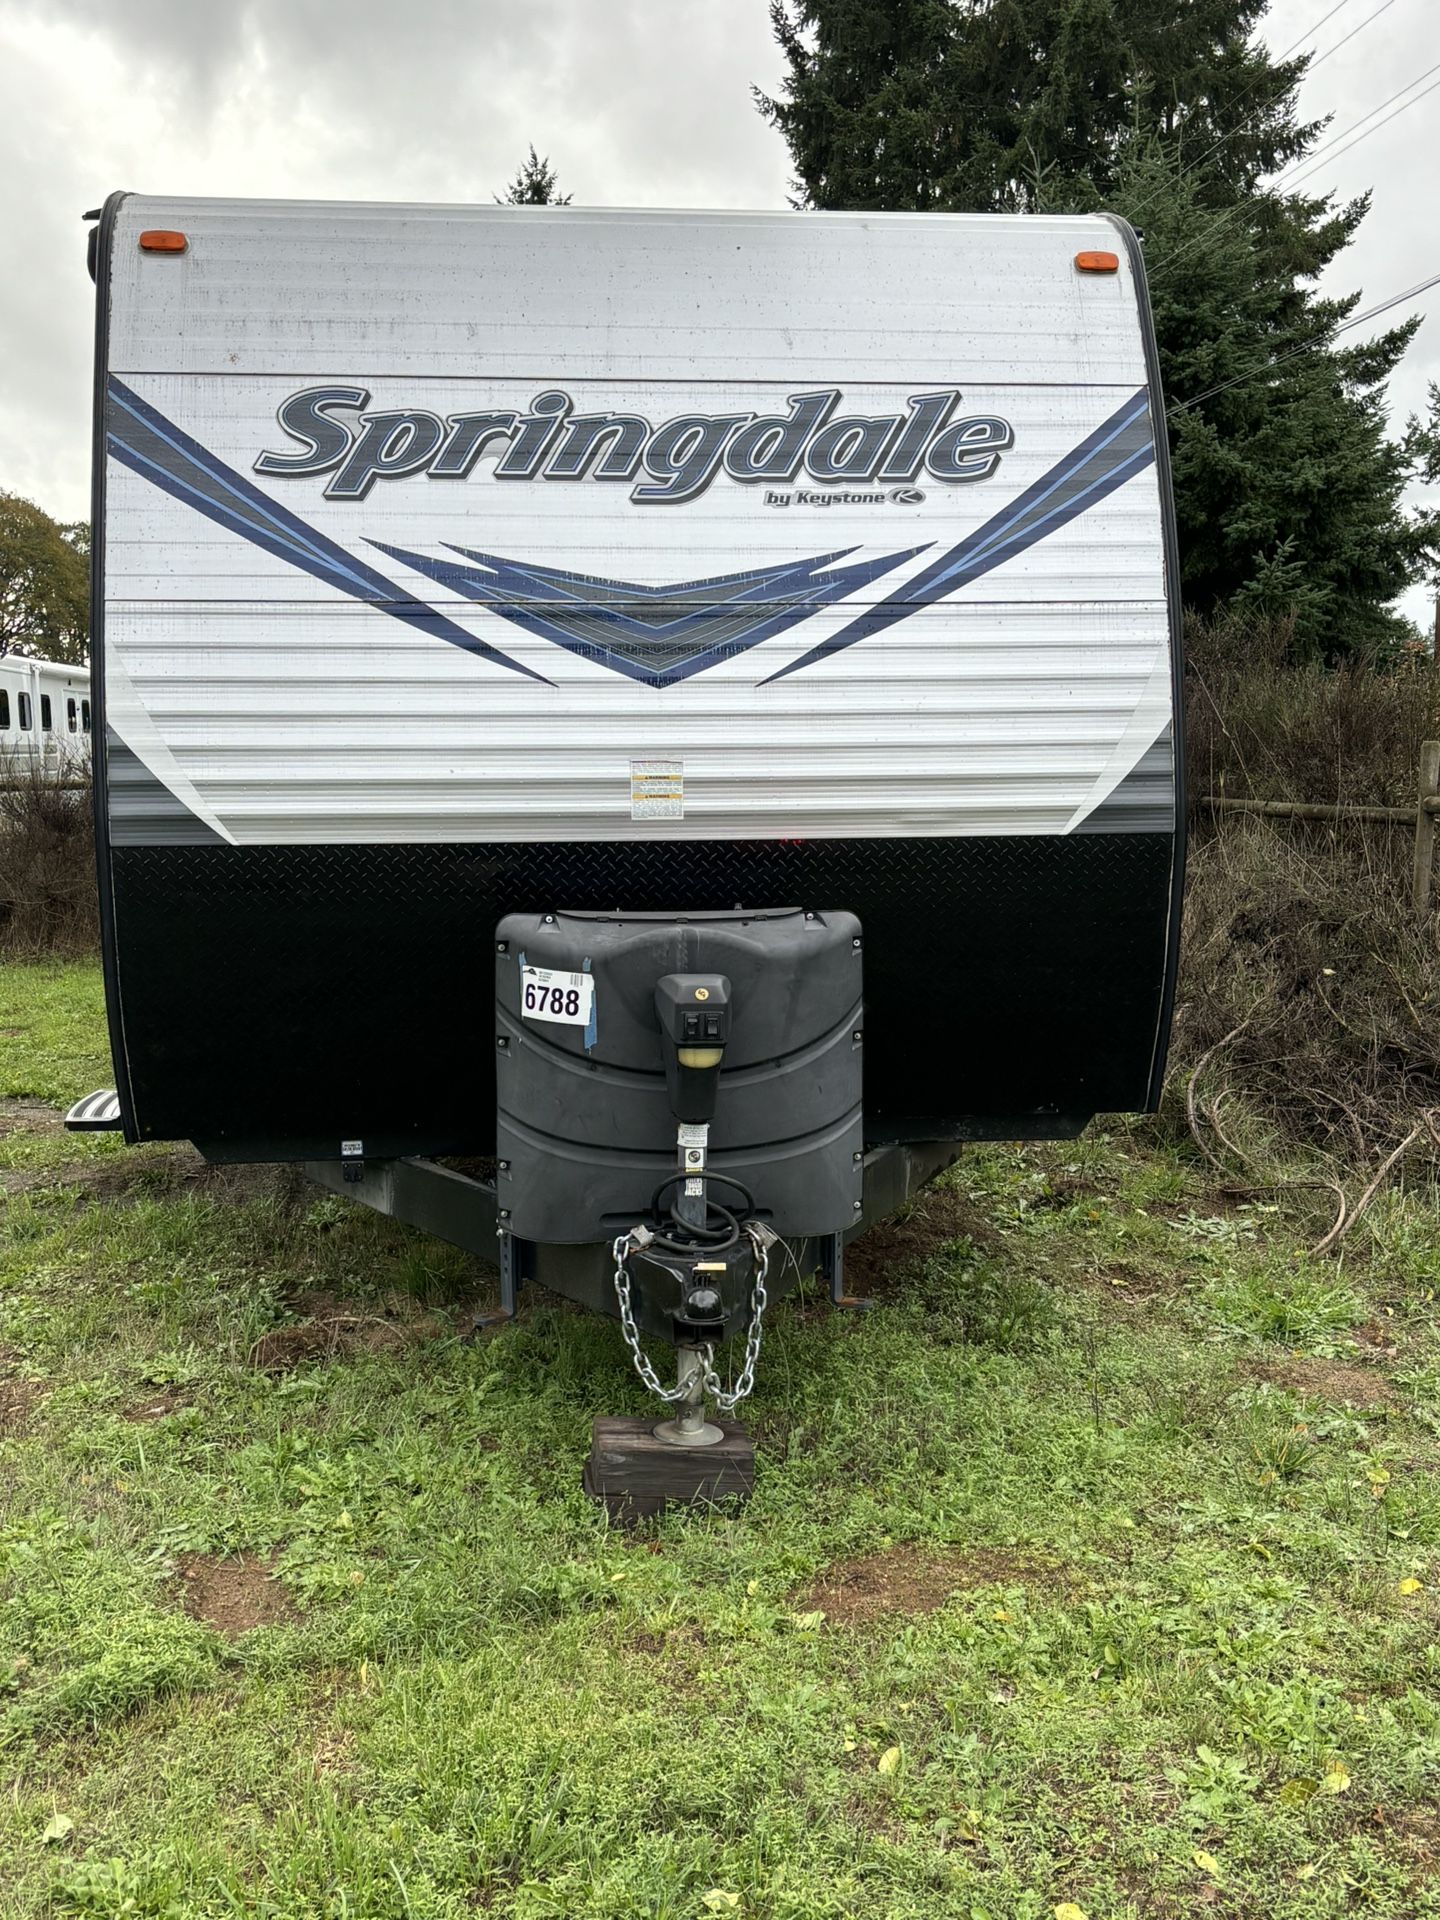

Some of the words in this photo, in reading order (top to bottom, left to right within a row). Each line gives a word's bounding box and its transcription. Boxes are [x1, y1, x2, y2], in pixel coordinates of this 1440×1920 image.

[253, 385, 1014, 504] Springdale
[767, 492, 790, 507] by
[797, 492, 885, 507] Keystone
[525, 983, 580, 1017] 6788
